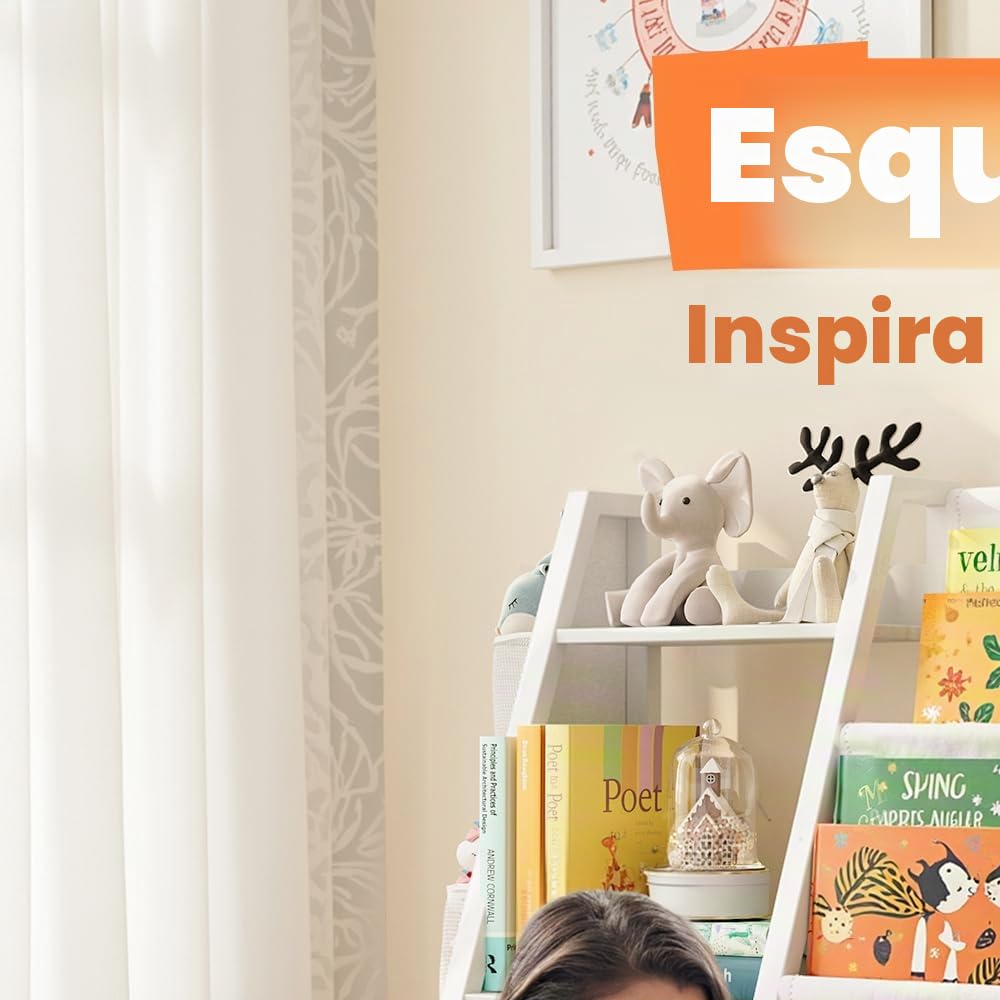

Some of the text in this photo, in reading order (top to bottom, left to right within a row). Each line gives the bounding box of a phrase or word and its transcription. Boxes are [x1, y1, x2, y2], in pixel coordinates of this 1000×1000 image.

[489, 743, 498, 770] Principles
[489, 771, 498, 782] and
[489, 783, 498, 808] Practices
[602, 778, 663, 813] Poet
[485, 848, 496, 925] ANDREW CORNWALL
